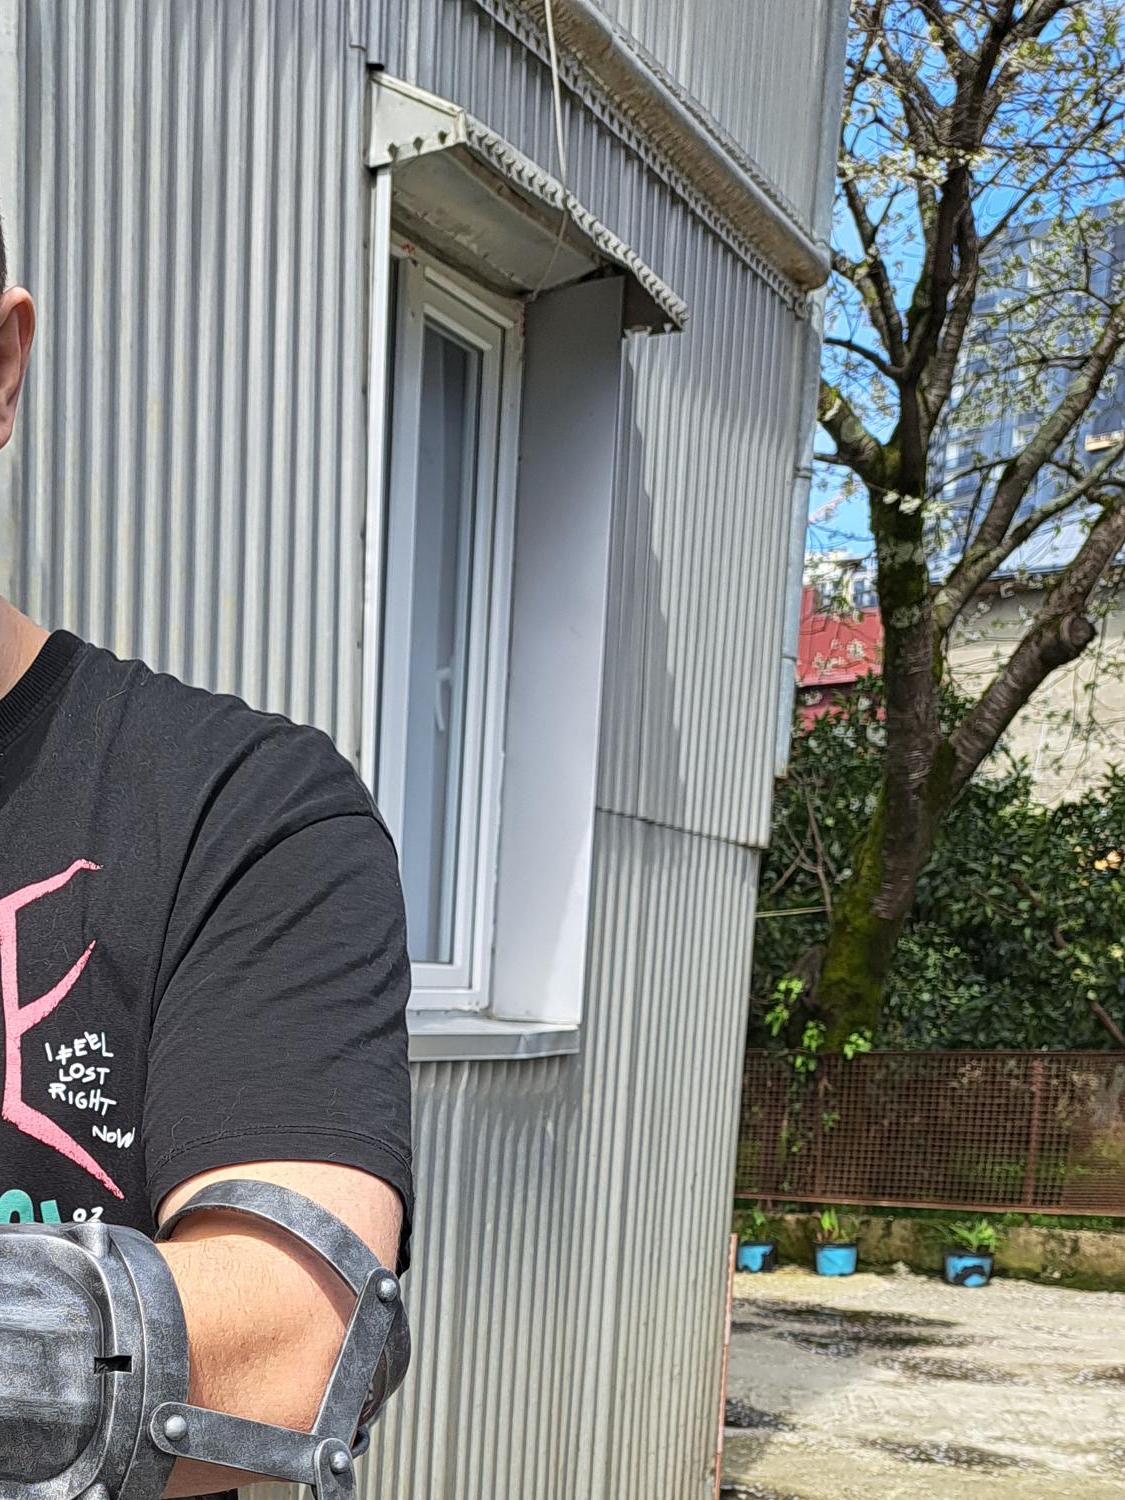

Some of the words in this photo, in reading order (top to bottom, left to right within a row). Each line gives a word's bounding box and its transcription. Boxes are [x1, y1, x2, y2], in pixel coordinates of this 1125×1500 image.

[44, 1042, 53, 1062] I
[55, 1031, 114, 1065] FEEL
[59, 1063, 110, 1085] LOST
[48, 1082, 117, 1116] RIGHT
[92, 1125, 135, 1149] NOW
